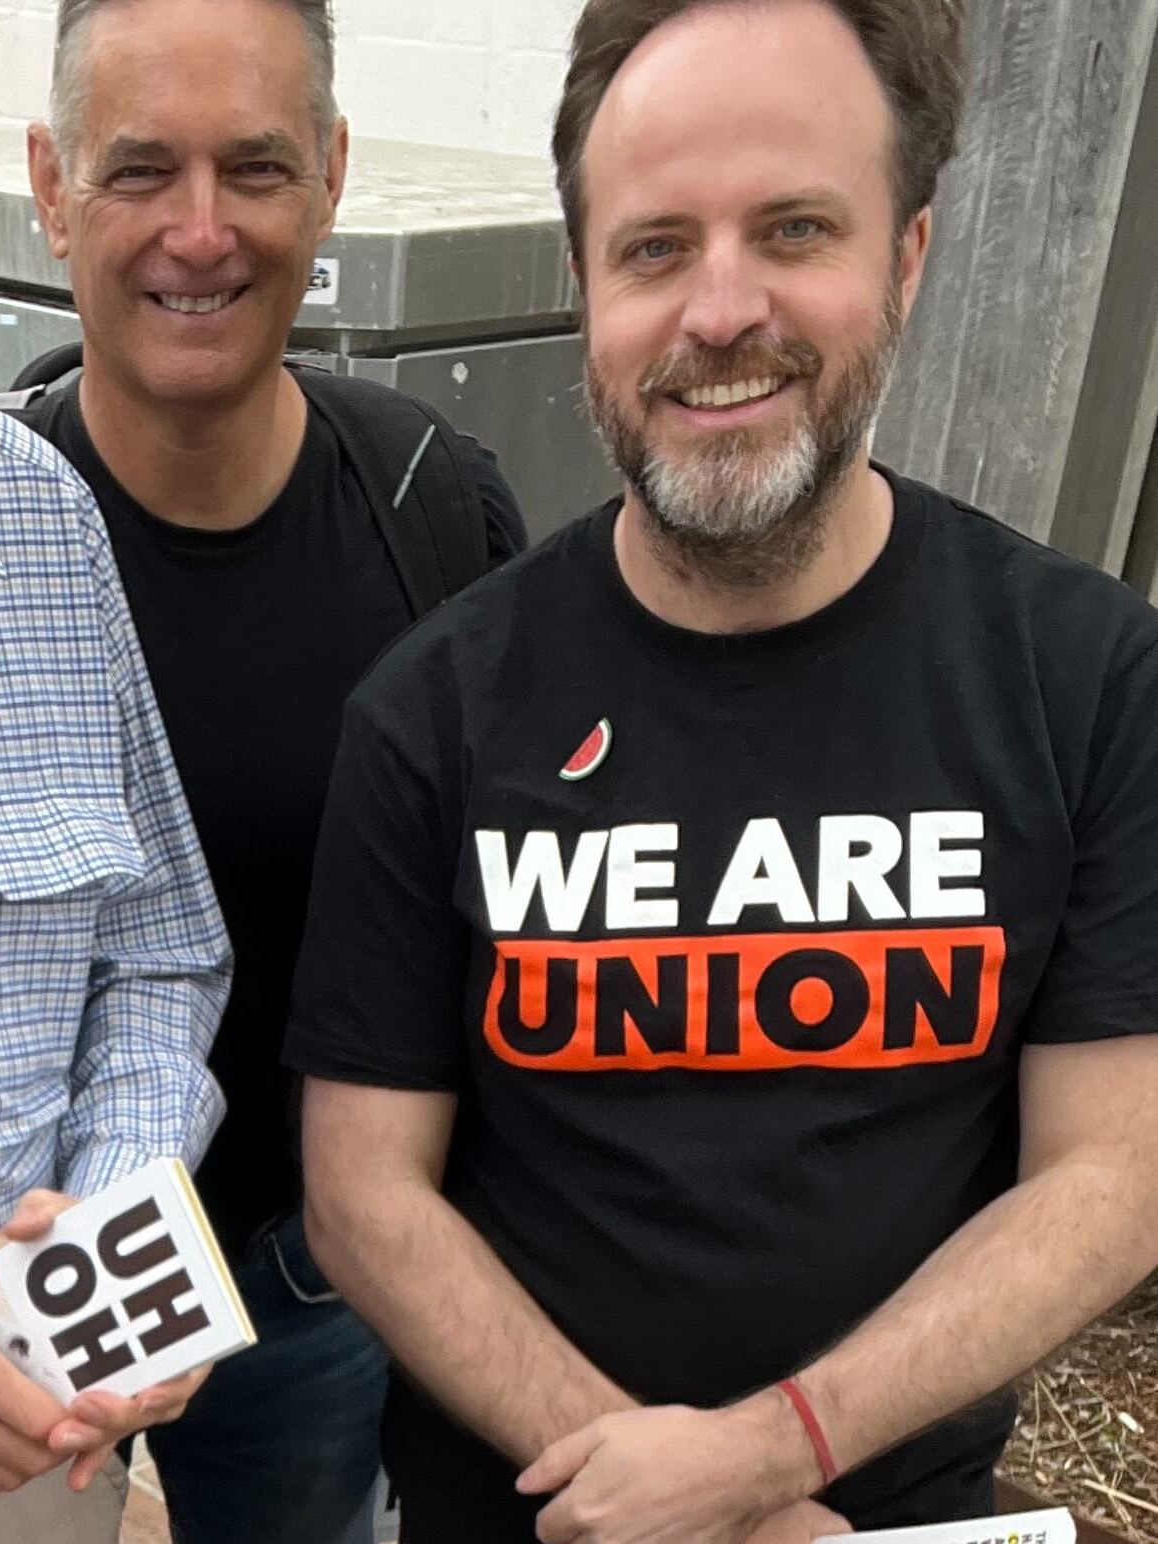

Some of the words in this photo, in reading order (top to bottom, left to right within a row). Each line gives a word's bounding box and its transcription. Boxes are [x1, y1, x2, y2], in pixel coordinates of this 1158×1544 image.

[475, 822, 679, 932] WE
[706, 811, 986, 925] ARE
[497, 944, 985, 1056] UNION
[26, 1242, 138, 1392] OH
[96, 1195, 212, 1358] UH
